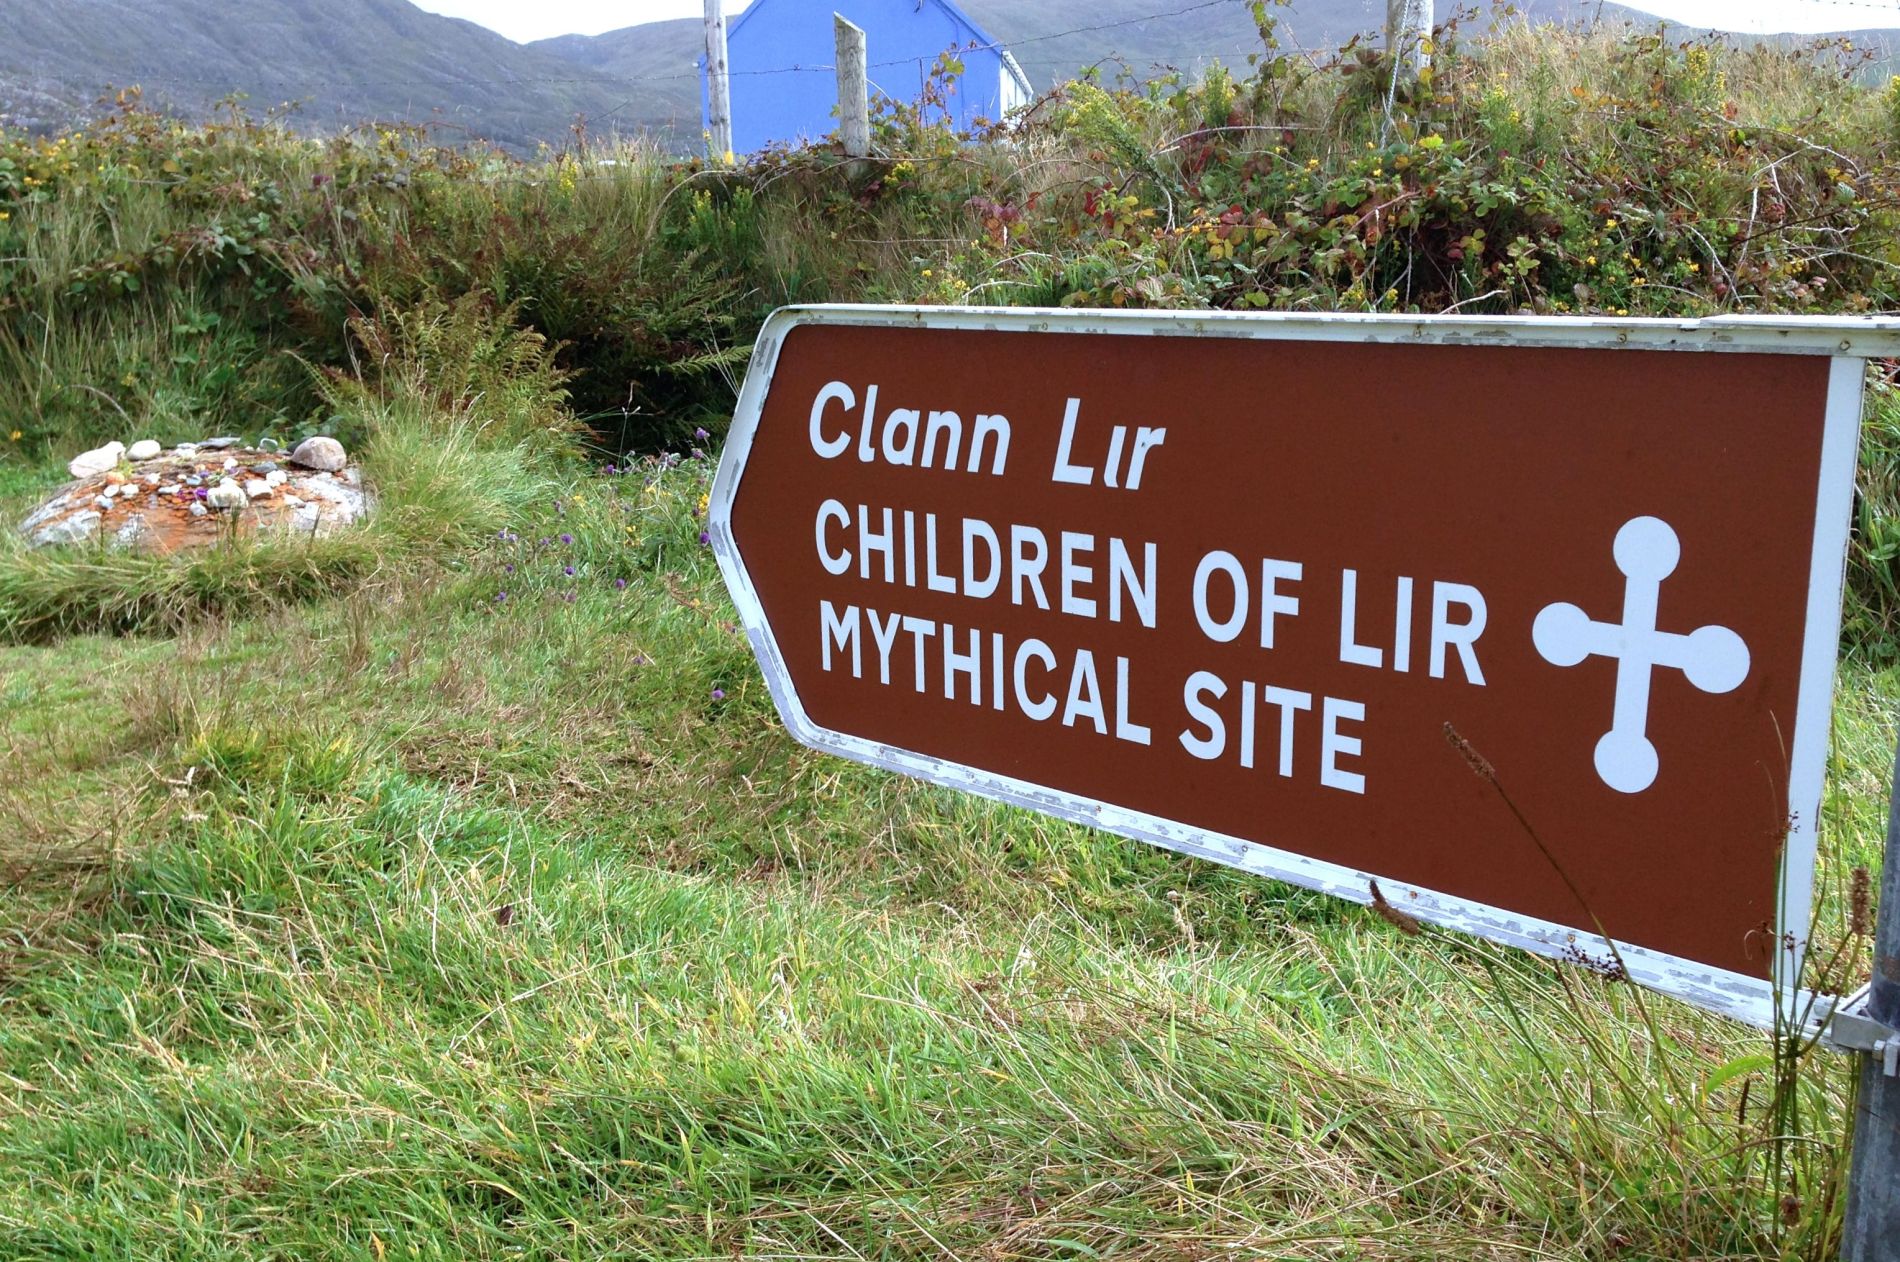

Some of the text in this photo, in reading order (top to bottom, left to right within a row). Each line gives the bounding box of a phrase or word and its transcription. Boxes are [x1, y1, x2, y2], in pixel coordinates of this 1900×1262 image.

[809, 380, 1011, 476] Clann
[815, 498, 1488, 686] CHILDREN OF LIR
[819, 599, 1367, 795] MYTHICAL SITE
